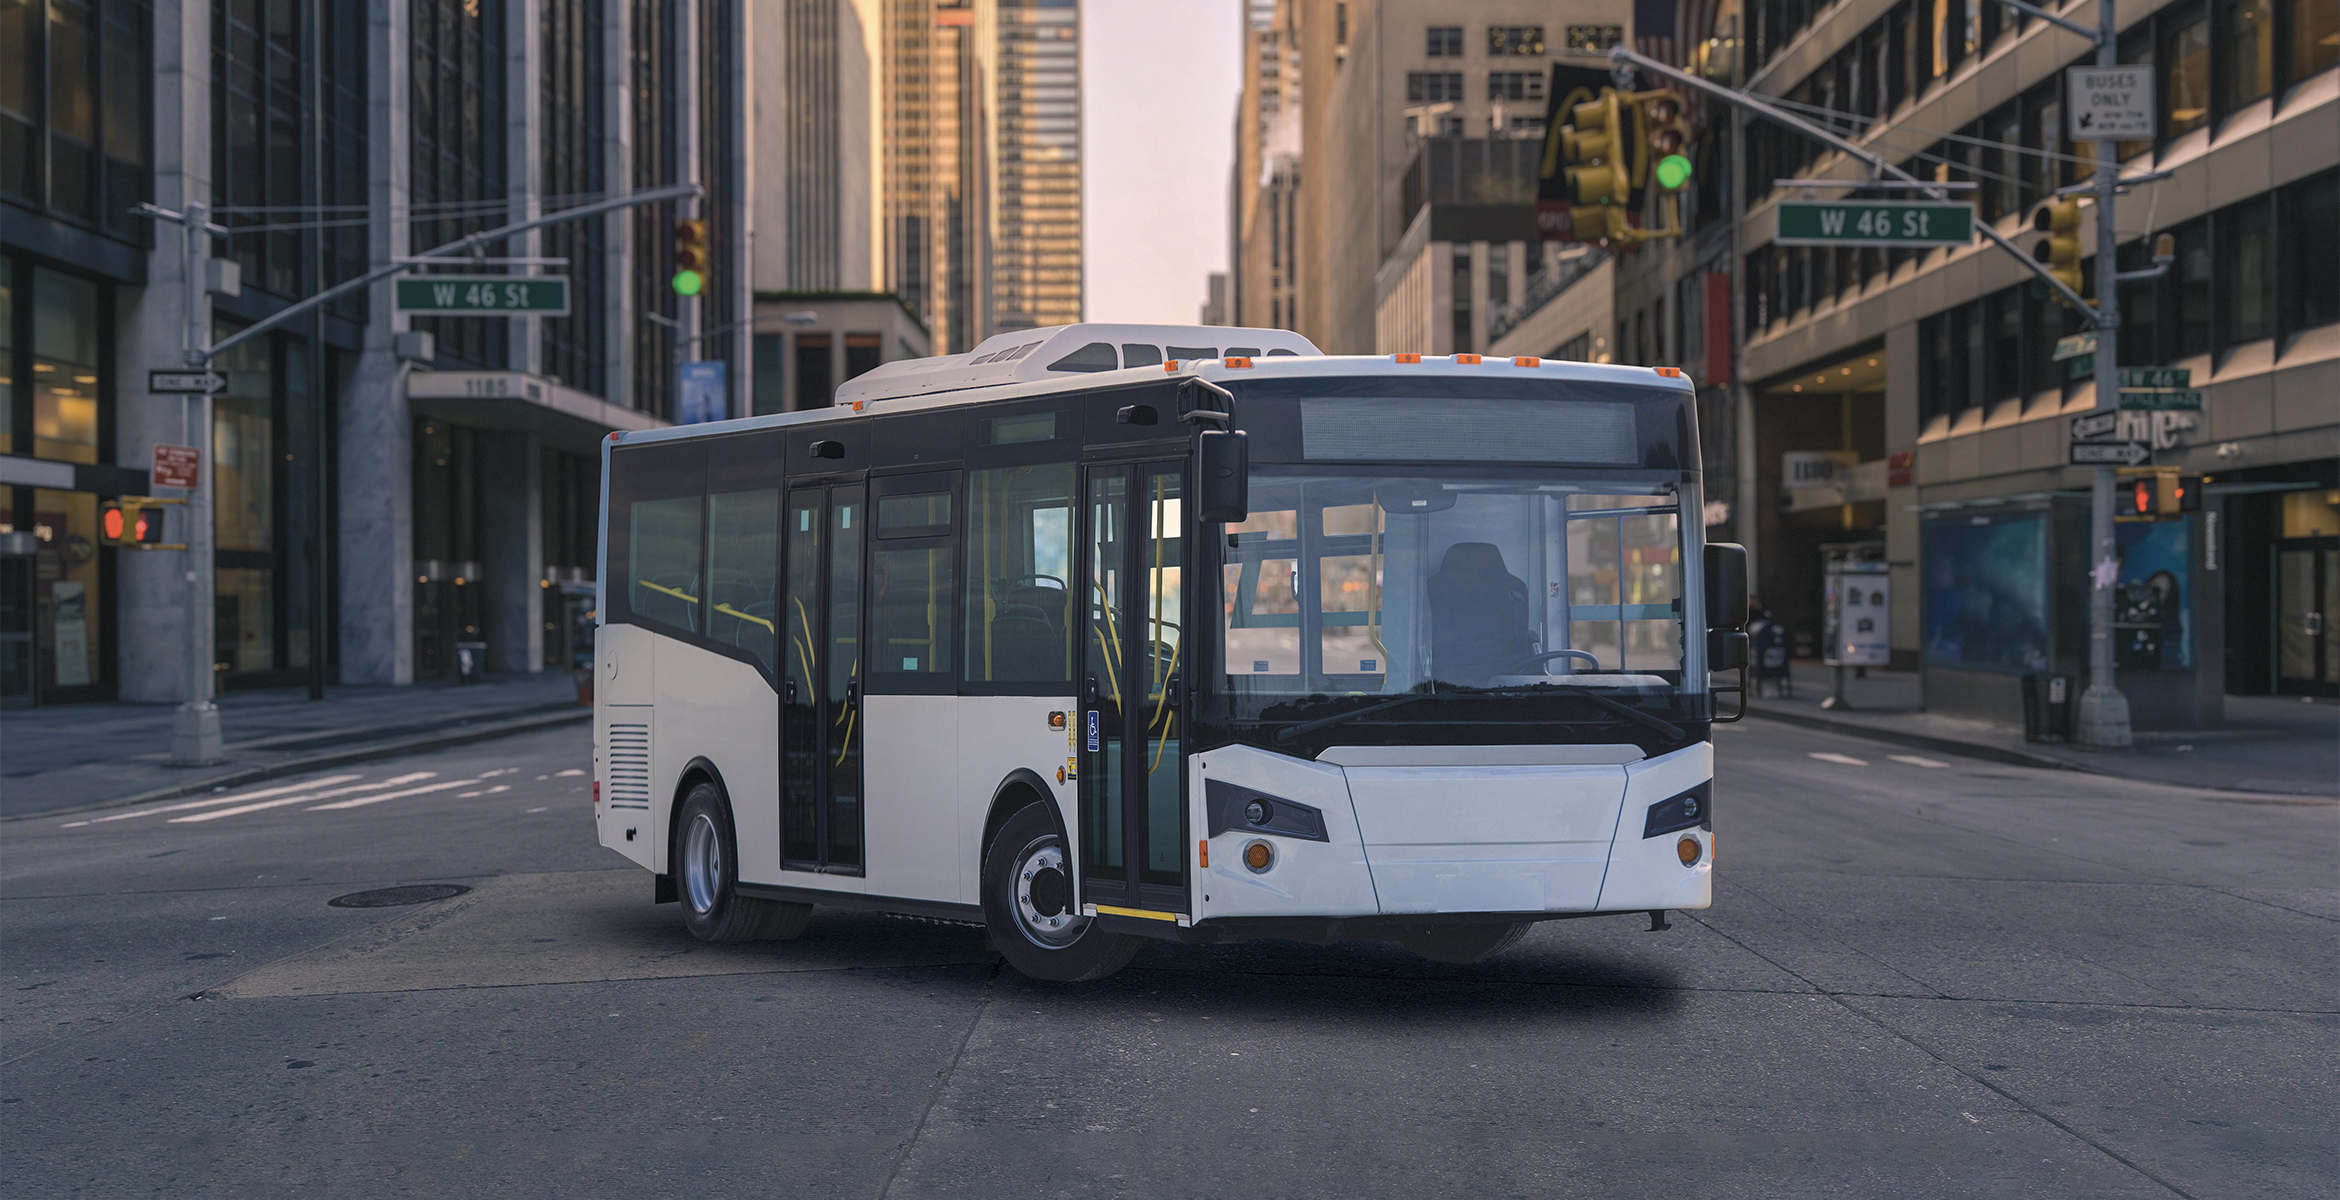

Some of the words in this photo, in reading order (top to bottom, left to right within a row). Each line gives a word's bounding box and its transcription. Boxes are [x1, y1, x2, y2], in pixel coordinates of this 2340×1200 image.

[2085, 73, 2137, 89] BUSES
[2090, 91, 2131, 107] ONLY
[1820, 208, 1846, 236] W
[1856, 209, 1892, 237] 46
[1901, 209, 1931, 238] St
[433, 283, 456, 307] W
[465, 283, 497, 307] 46
[505, 283, 530, 308] St
[193, 376, 217, 388] WAY
[2152, 370, 2175, 387] 46
[465, 379, 508, 396] 1185
